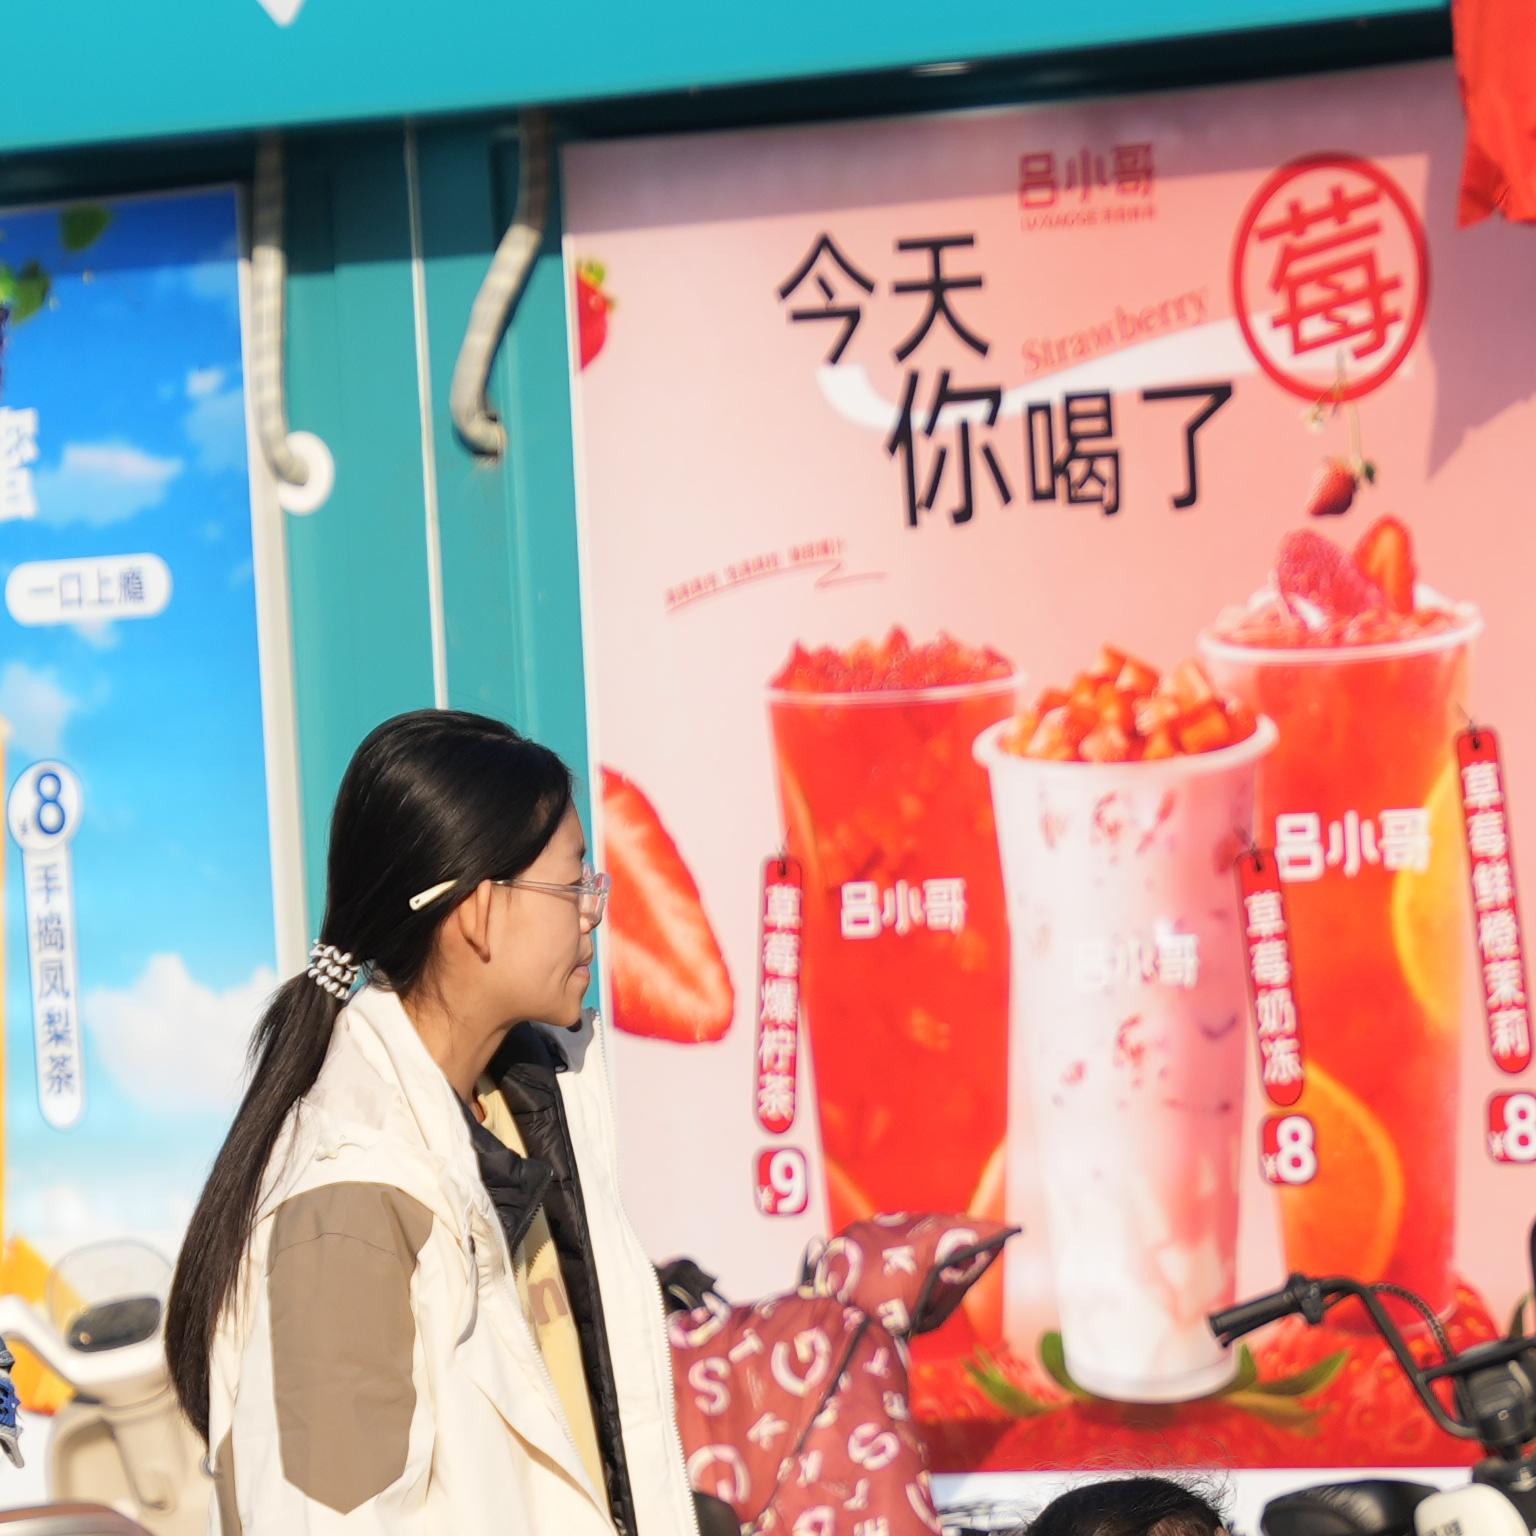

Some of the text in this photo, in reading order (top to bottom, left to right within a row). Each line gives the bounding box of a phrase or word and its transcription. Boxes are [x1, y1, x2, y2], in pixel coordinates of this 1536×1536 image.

[1019, 143, 1154, 209] 吕小哥
[776, 231, 990, 366] 今天
[1255, 182, 1404, 362] 莓
[1021, 287, 1208, 373] Strawberry
[885, 367, 1235, 527] 你喝了
[1275, 808, 1432, 883] 吕小哥
[840, 877, 968, 940] 吕小哥
